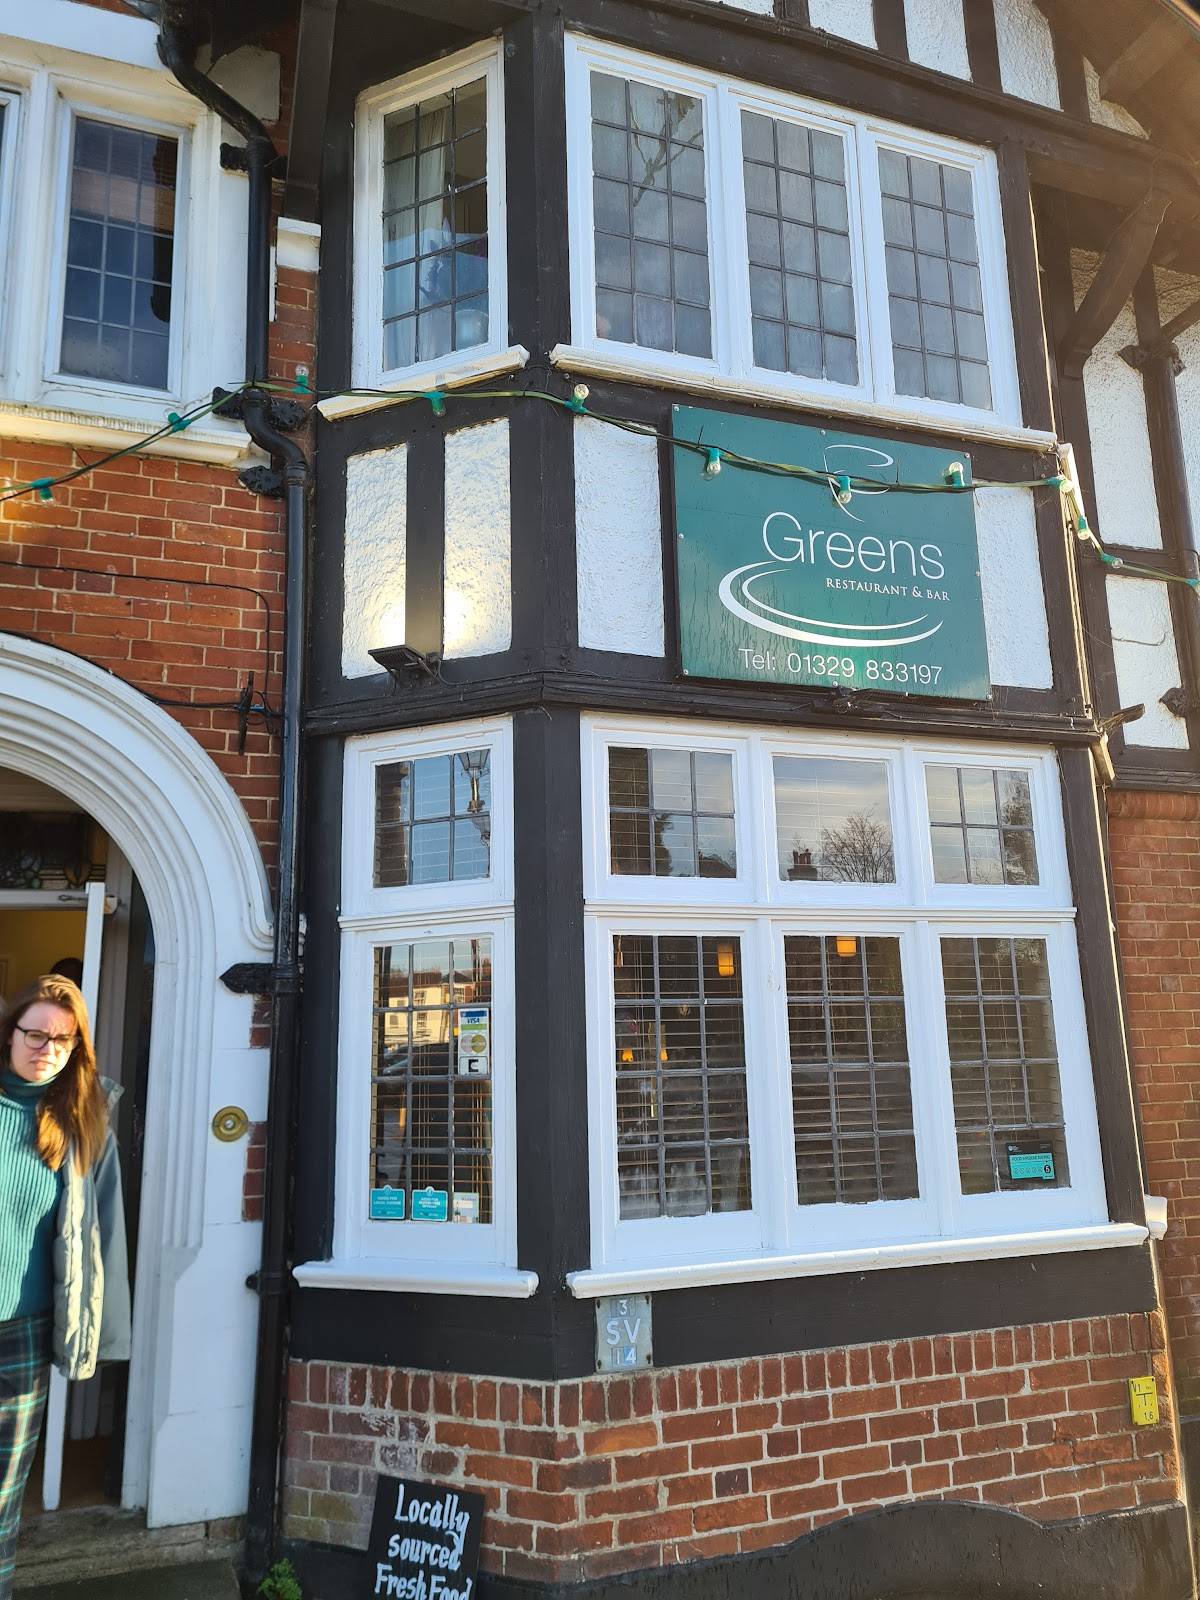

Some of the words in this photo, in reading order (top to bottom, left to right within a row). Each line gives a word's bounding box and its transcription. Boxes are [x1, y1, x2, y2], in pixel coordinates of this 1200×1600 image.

[763, 511, 945, 580] Greens
[826, 577, 908, 596] RESTAURANT
[912, 586, 923, 598] &
[927, 589, 950, 601] BAR
[738, 648, 776, 671] Tel:
[787, 652, 855, 678] 01329
[866, 660, 943, 685] 833197
[619, 1299, 628, 1315] 3
[606, 1318, 641, 1345] SV
[616, 1347, 637, 1365] 14
[394, 1483, 470, 1555] Locally
[387, 1530, 462, 1572] sourced
[374, 1562, 427, 1600] Fresh
[428, 1574, 473, 1600] Food
